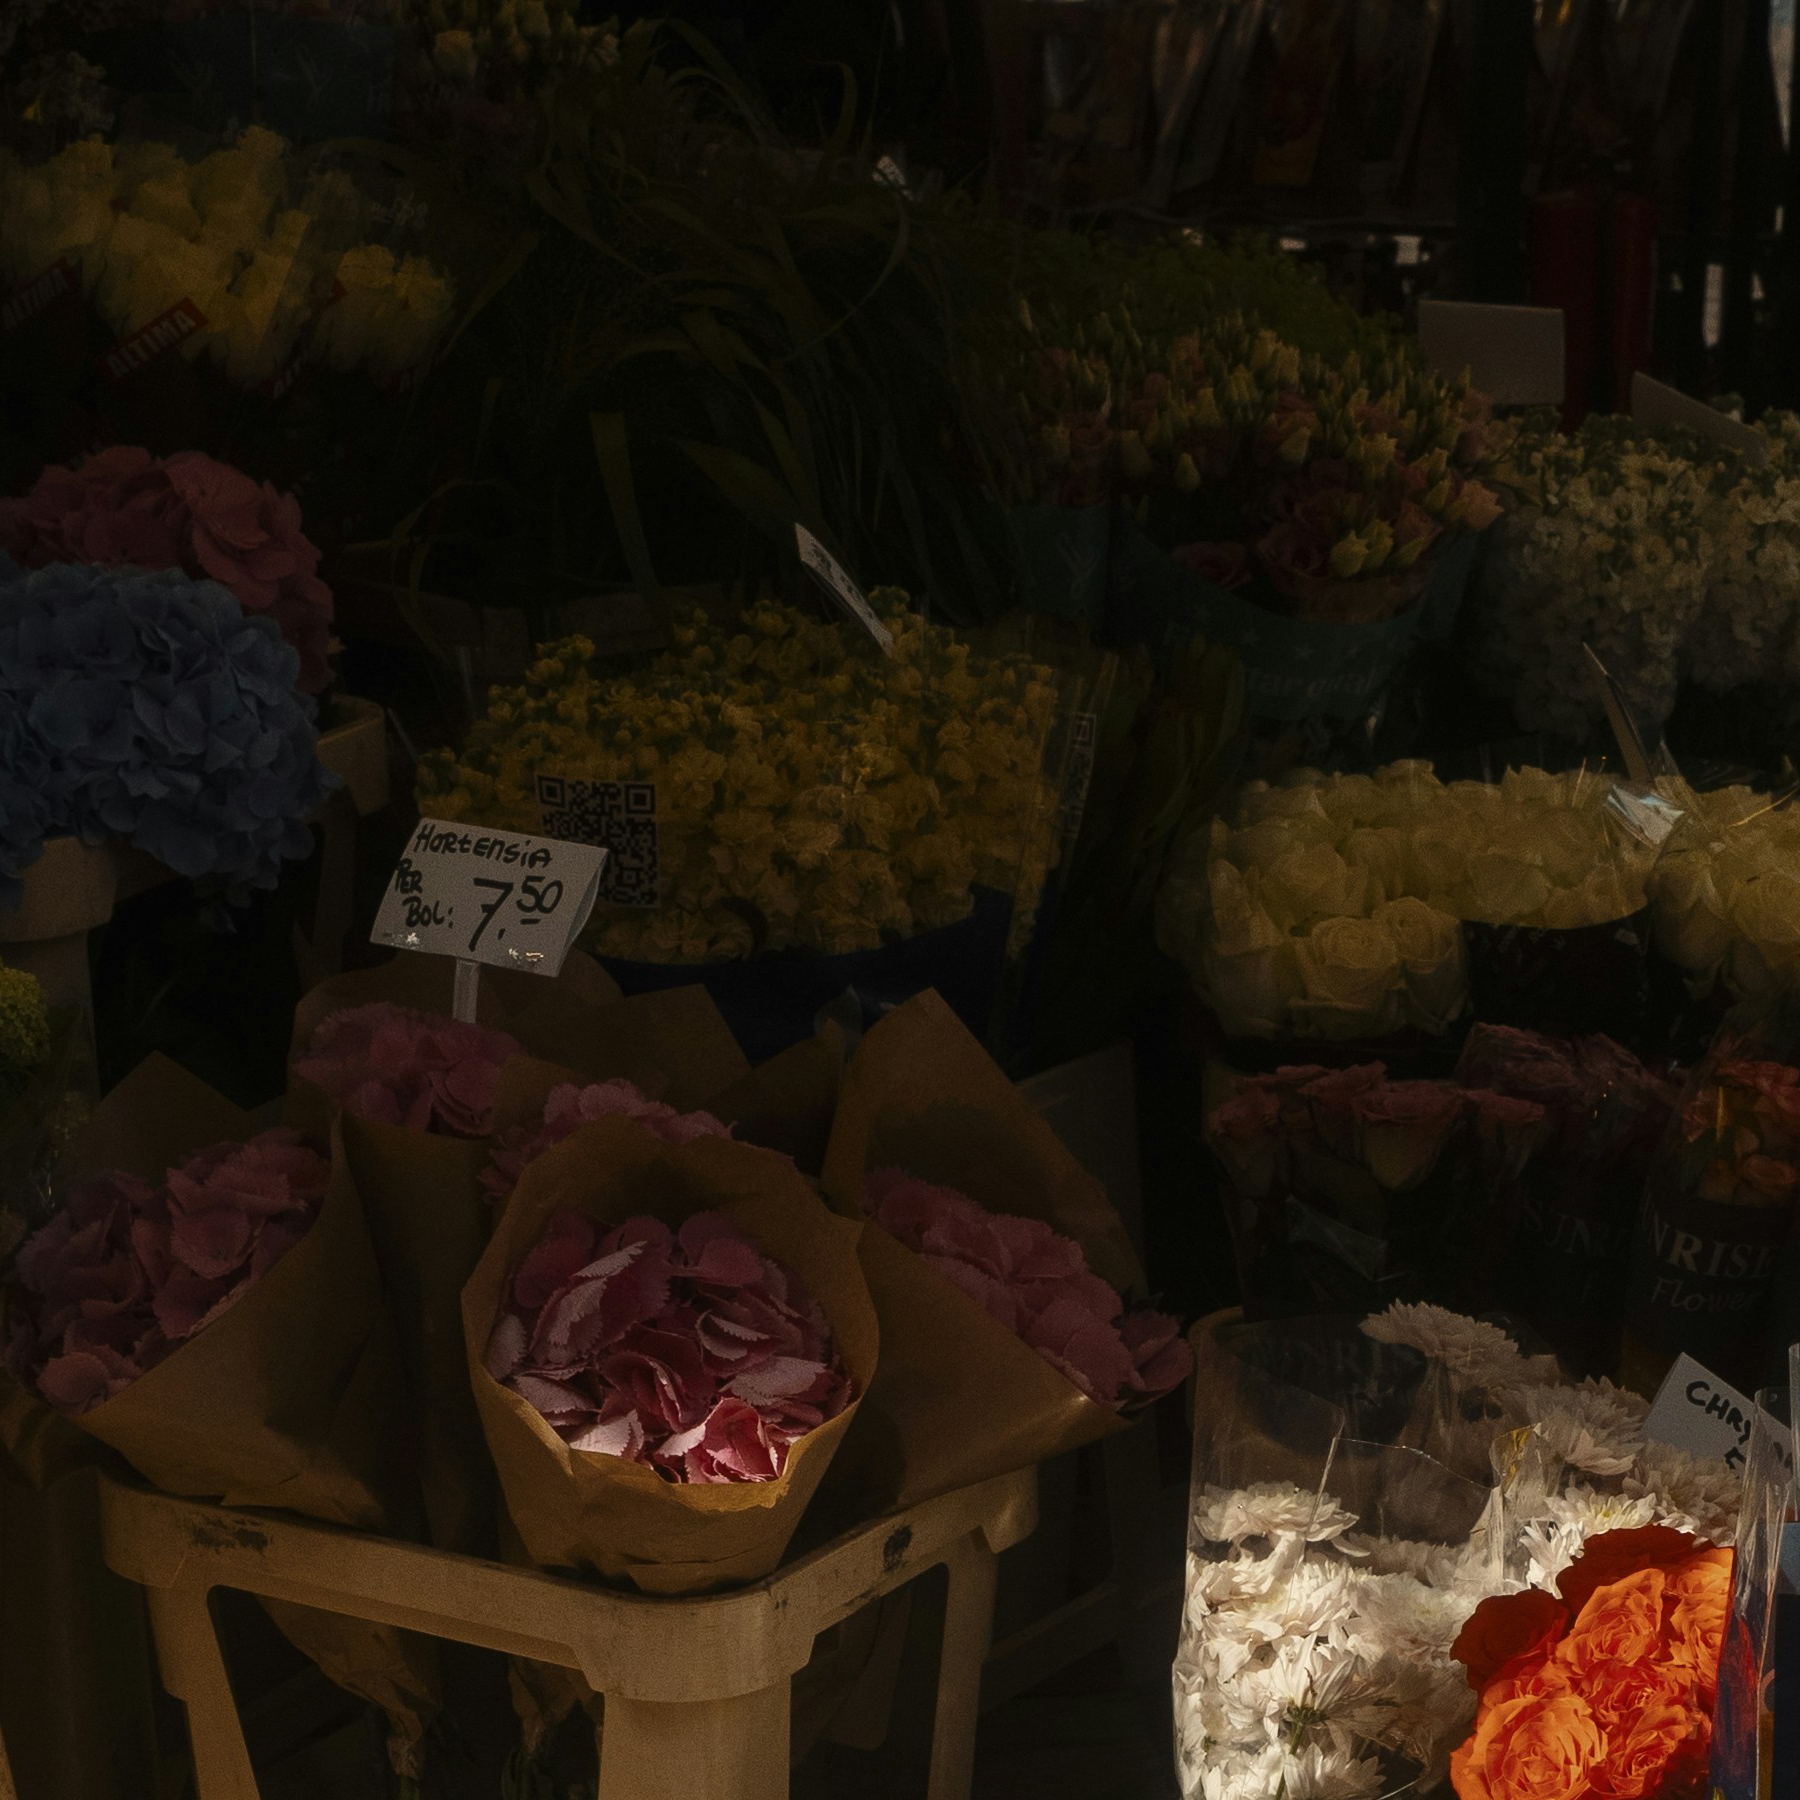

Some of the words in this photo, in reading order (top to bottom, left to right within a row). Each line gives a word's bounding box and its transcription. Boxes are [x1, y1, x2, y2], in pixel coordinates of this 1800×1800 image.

[2, 262, 72, 331] ALTIMA
[104, 307, 199, 383] ALTIMA
[395, 858, 422, 892] PER
